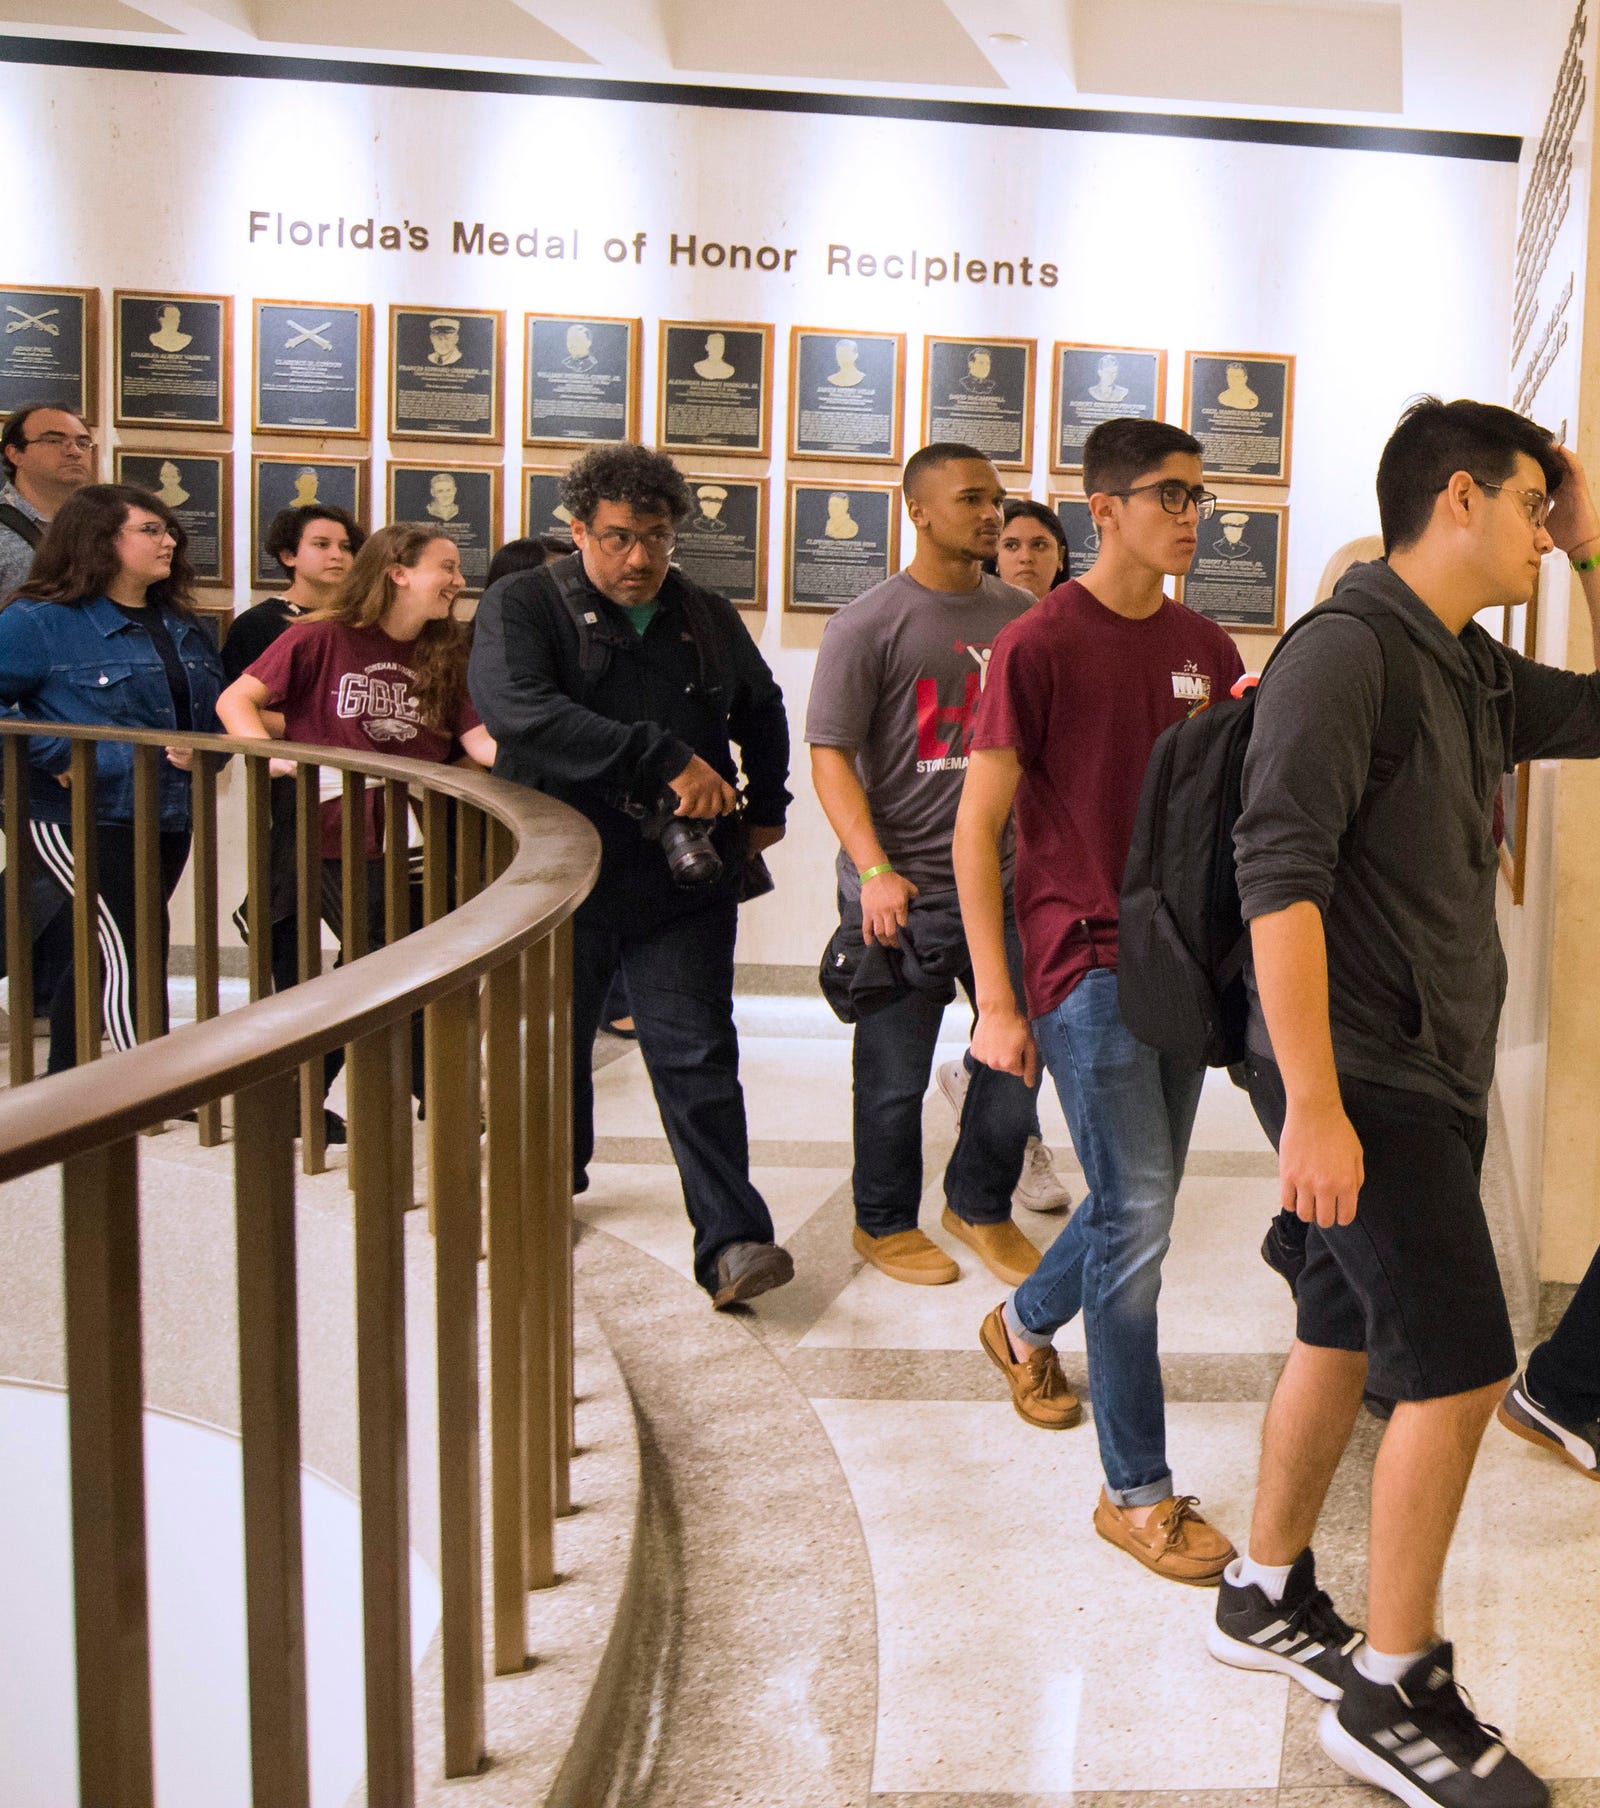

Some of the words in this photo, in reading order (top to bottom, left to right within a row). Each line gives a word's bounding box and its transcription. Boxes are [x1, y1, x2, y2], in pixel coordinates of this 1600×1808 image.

[249, 210, 430, 252] Florida's
[452, 221, 579, 261] Medal
[603, 231, 647, 264] of
[669, 233, 798, 272] Honor
[827, 243, 1060, 288] Recipients
[916, 756, 970, 774] STONEMA
